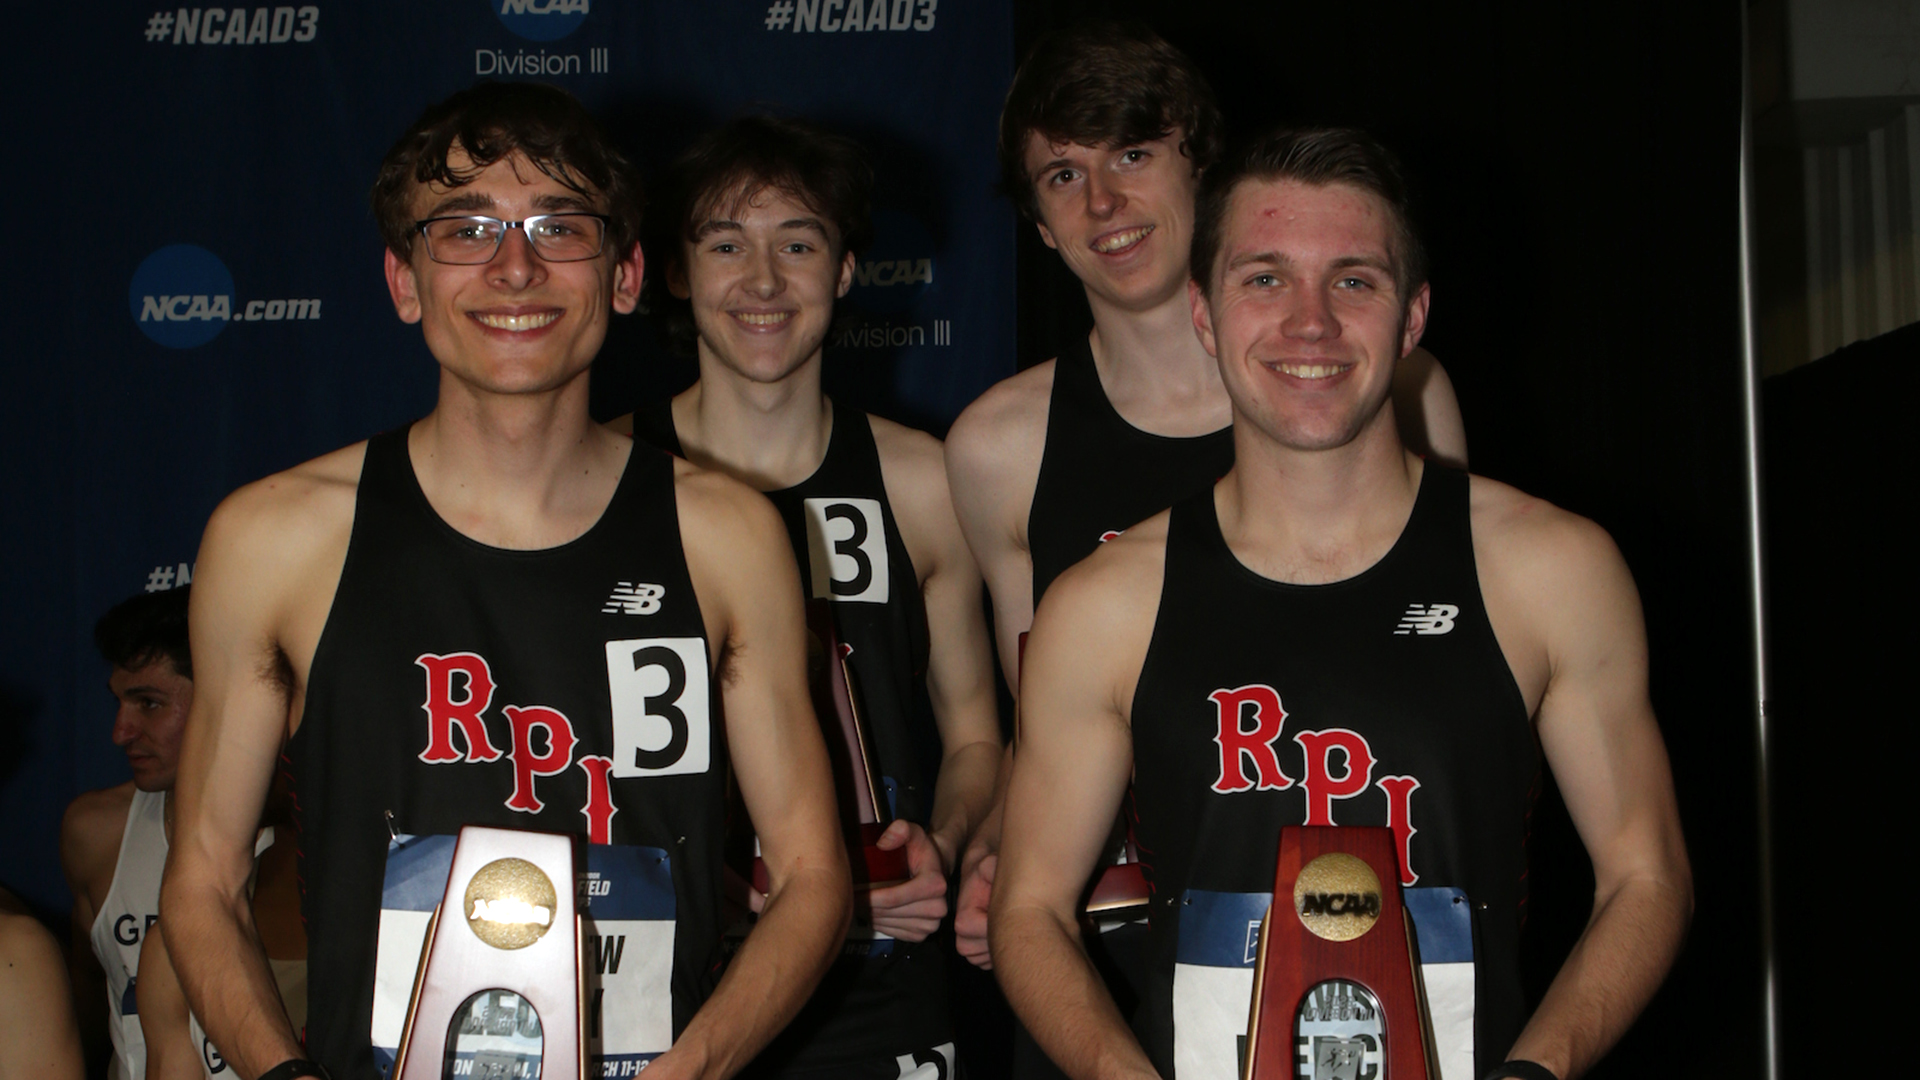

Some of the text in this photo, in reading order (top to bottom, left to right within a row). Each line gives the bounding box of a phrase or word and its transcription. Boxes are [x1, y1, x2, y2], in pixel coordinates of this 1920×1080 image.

[145, 6, 319, 45] #NCAAD3
[764, 0, 938, 34] #NCAAD3
[475, 47, 609, 75] Division III
[140, 295, 322, 321] NCAA.com
[824, 503, 873, 596] 3
[632, 645, 690, 770] 3
[413, 651, 620, 845] RPI
[1207, 683, 1422, 887] RPI
